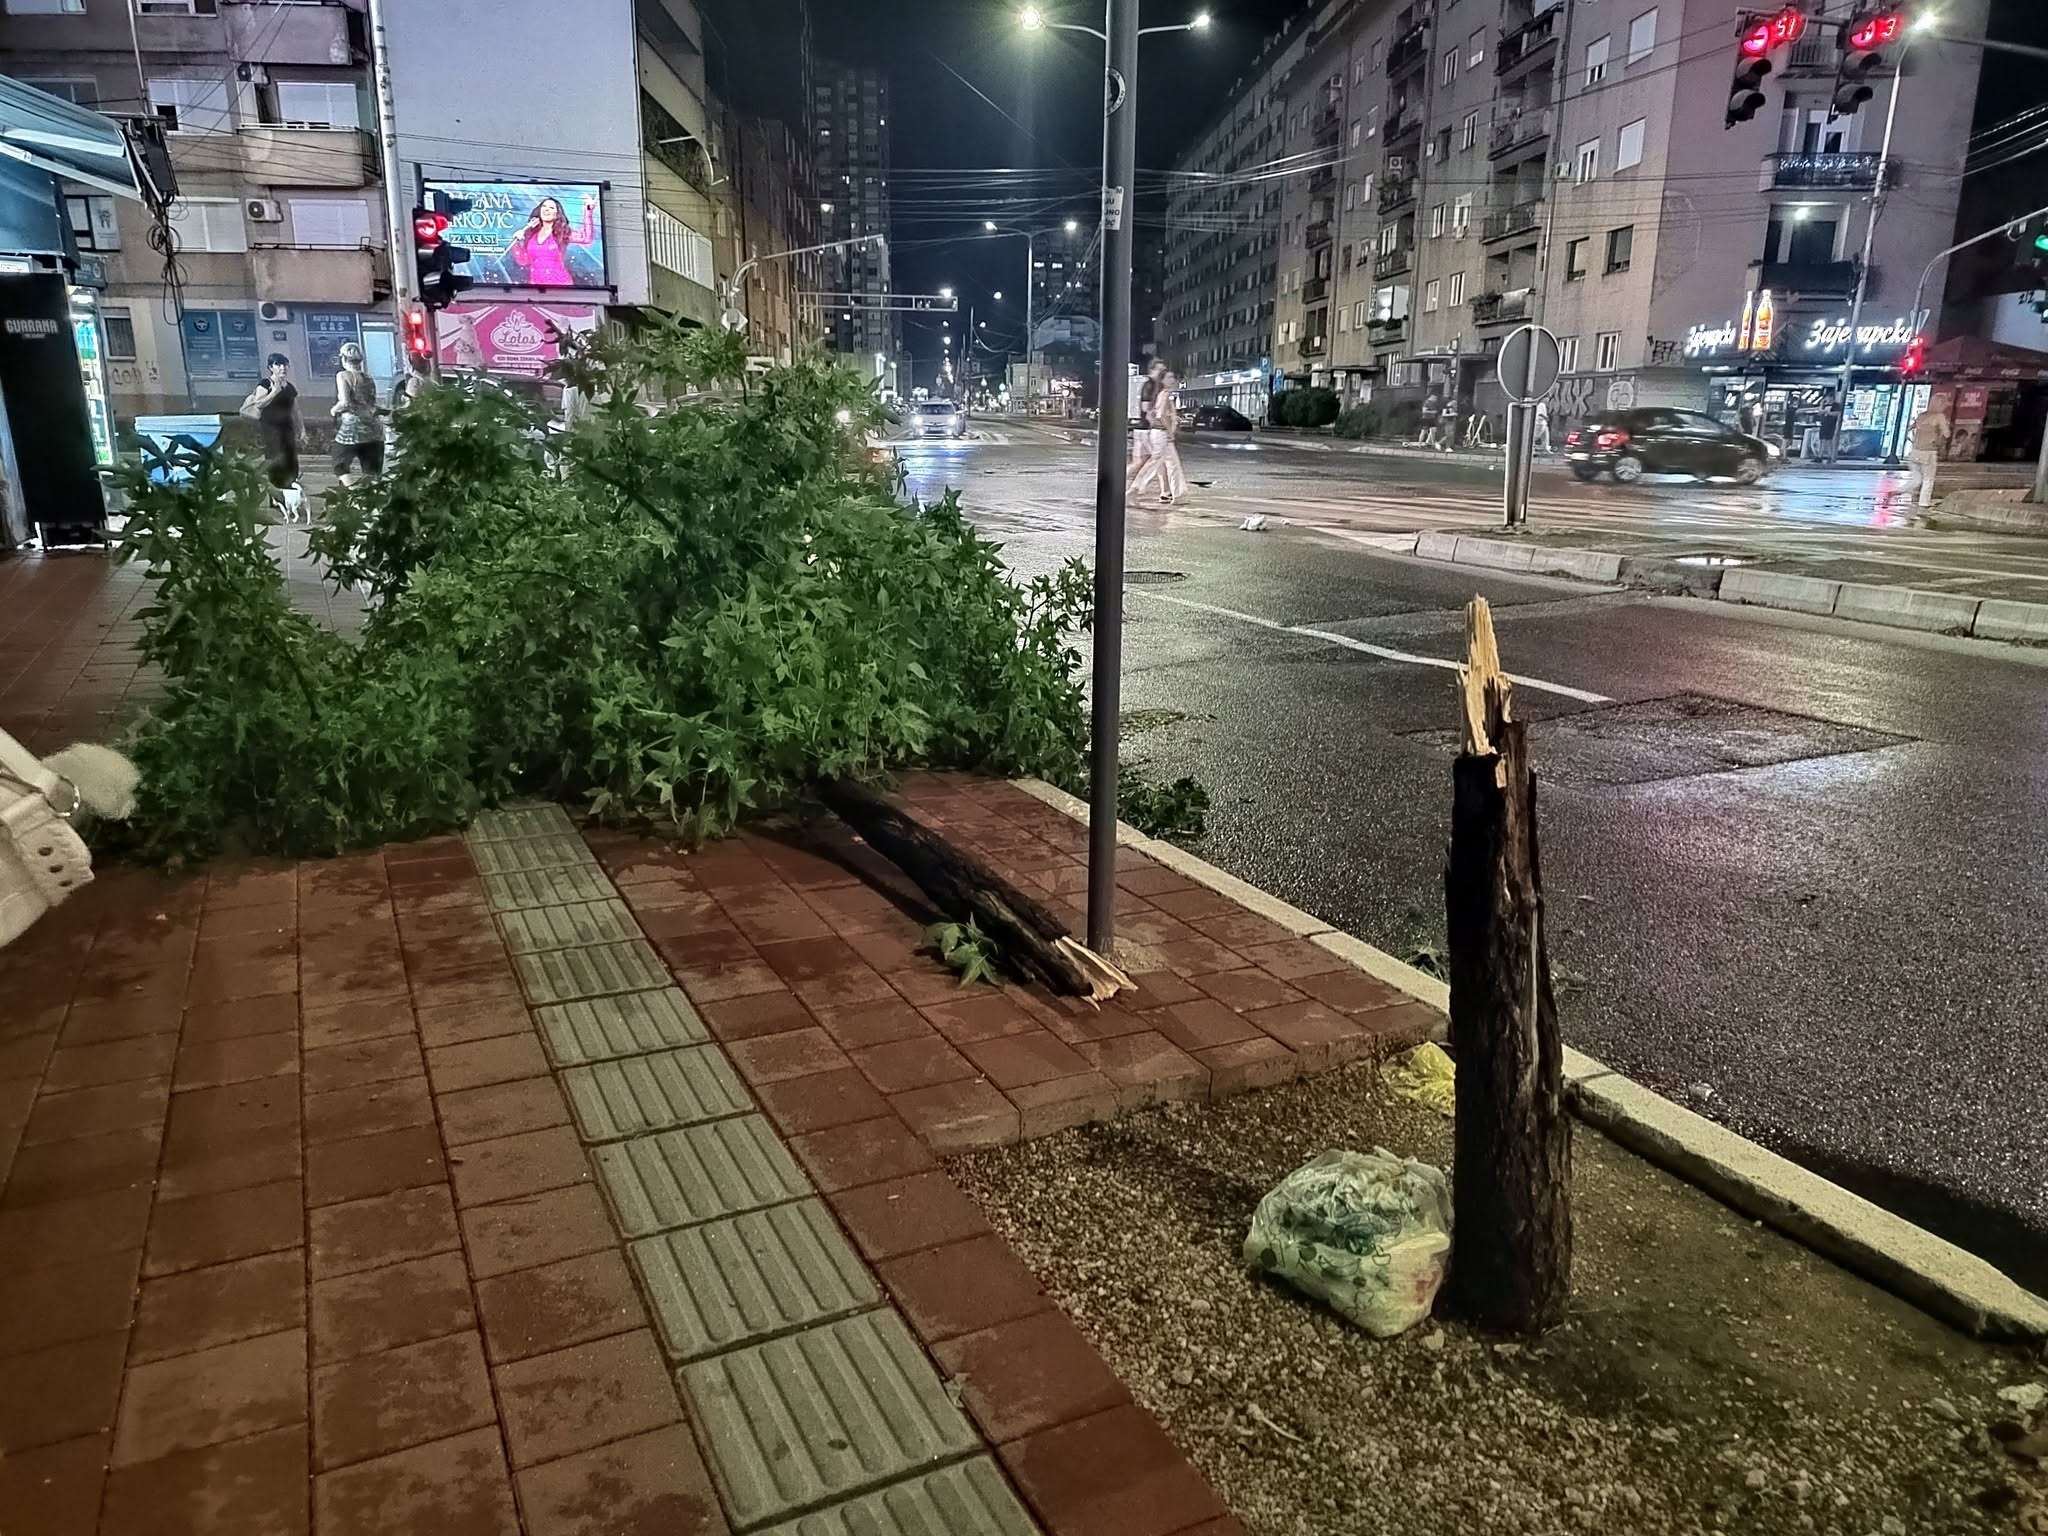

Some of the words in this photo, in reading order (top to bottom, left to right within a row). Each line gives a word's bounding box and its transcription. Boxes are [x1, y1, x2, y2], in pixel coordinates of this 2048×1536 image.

[448, 210, 515, 229] RKOVIĆ
[6, 319, 58, 334] GUARANA
[498, 330, 538, 345] Lotos
